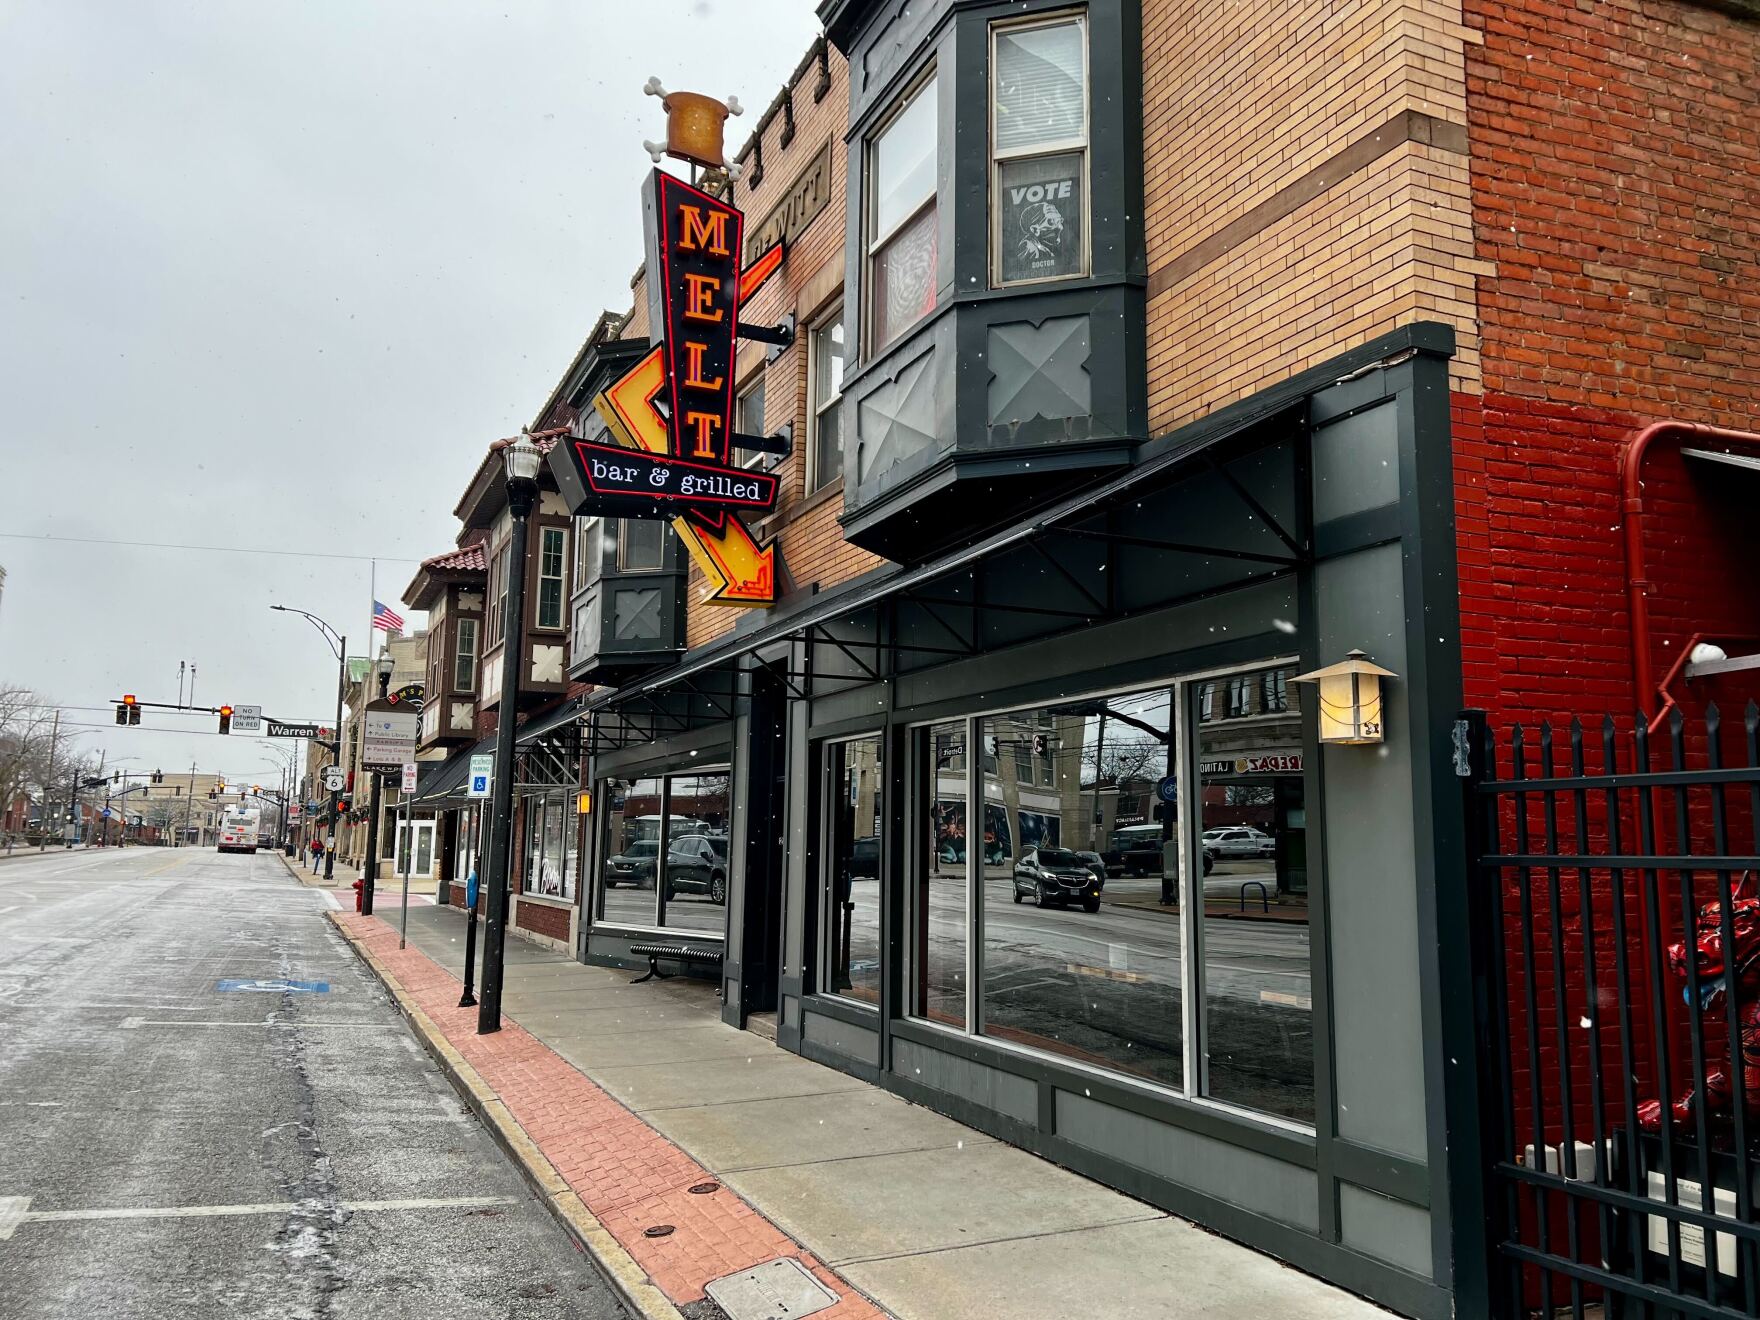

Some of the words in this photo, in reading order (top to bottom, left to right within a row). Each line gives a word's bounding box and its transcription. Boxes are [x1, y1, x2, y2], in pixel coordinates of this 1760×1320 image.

[775, 165, 822, 238] WITT
[1010, 180, 1072, 205] VOTE
[679, 204, 730, 459] MELT
[592, 459, 638, 483] bar
[649, 467, 670, 487] &
[680, 475, 761, 500] grilled
[270, 725, 314, 737] Warren
[331, 778, 338, 787] 6
